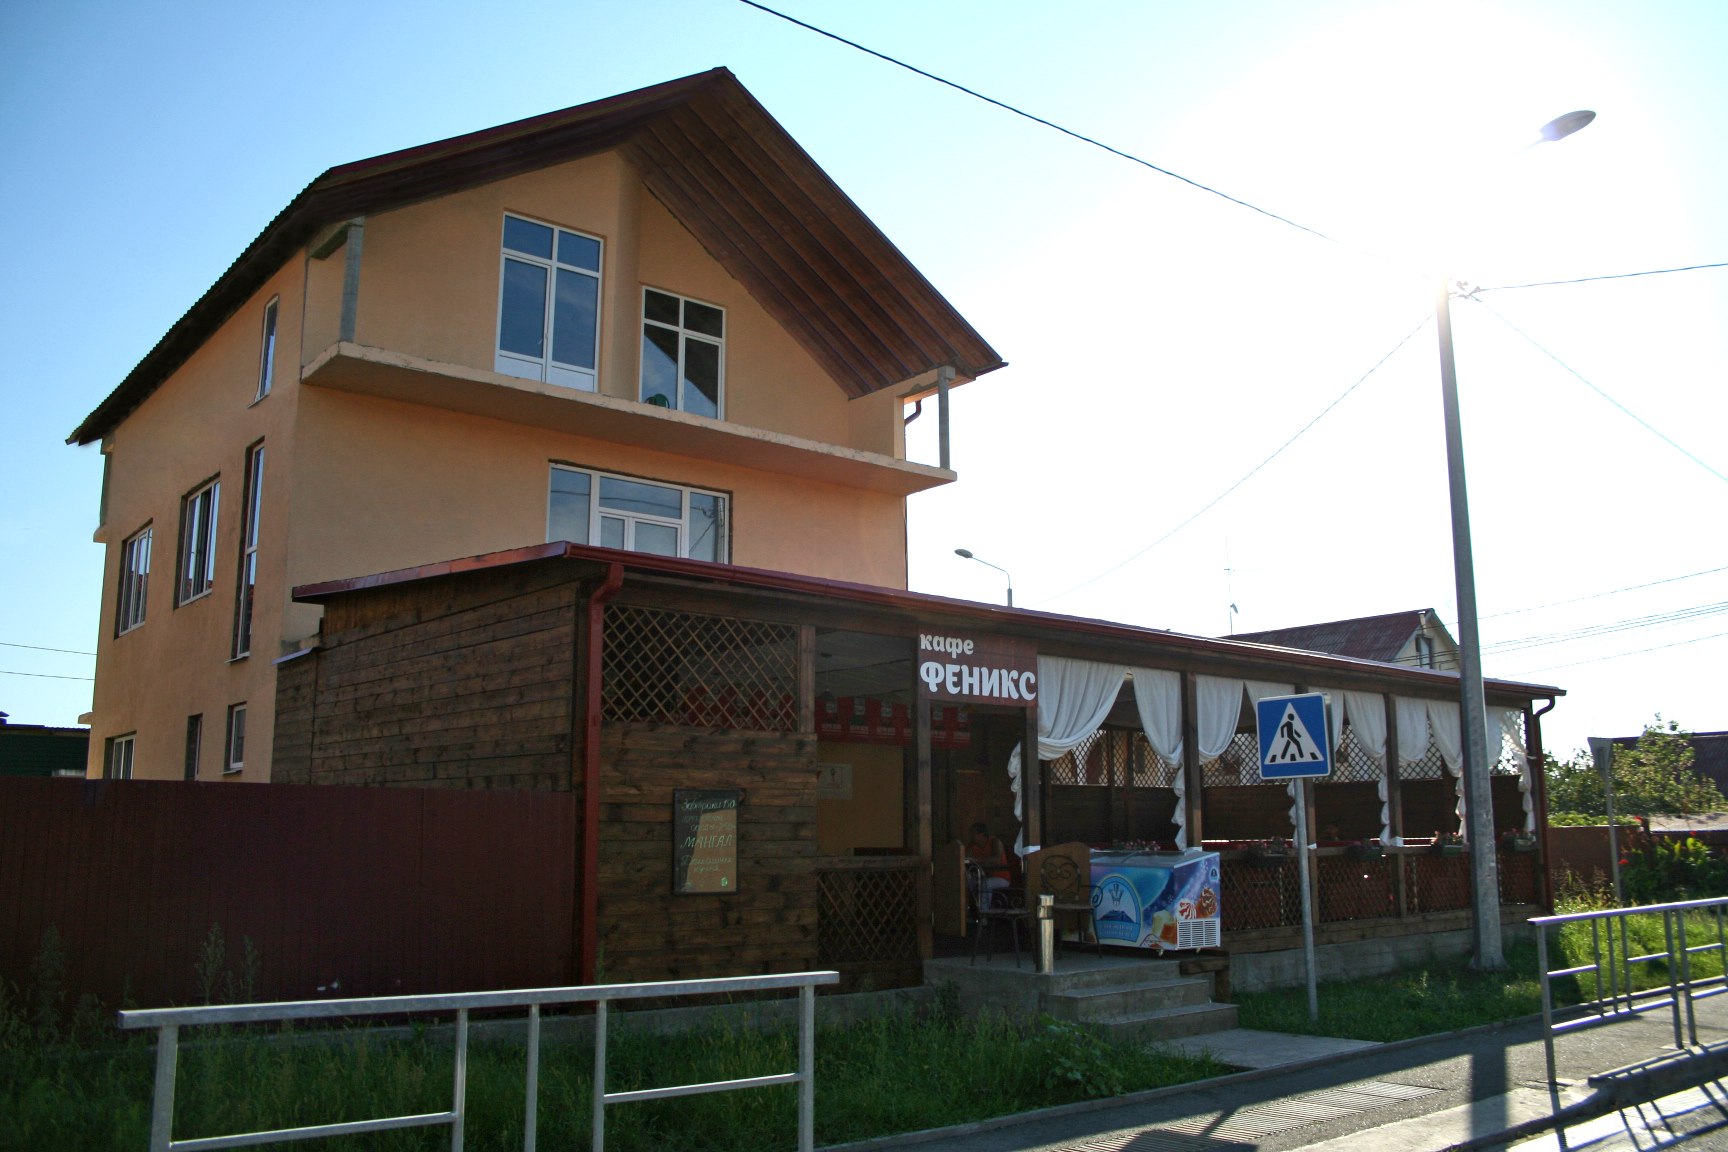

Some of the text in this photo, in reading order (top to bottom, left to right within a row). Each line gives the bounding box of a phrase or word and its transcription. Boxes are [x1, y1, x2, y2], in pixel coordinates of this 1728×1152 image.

[920, 633, 974, 659] кафе
[920, 661, 1037, 701] ФЕНИКС
[680, 834, 733, 849] МАНГАЛ
